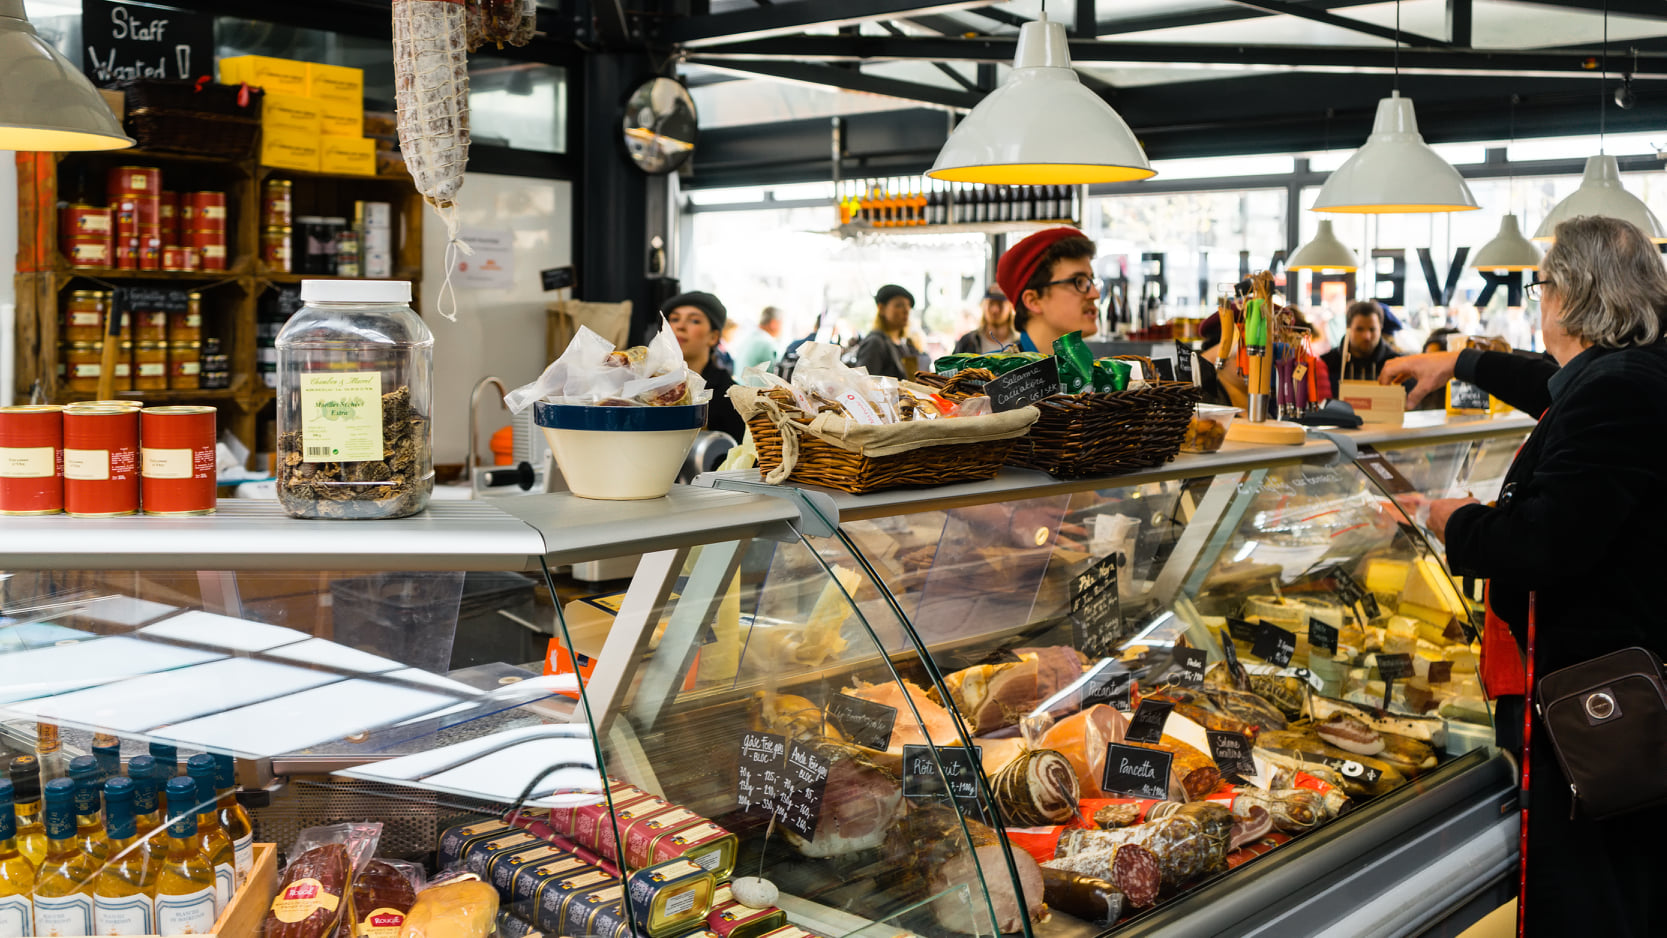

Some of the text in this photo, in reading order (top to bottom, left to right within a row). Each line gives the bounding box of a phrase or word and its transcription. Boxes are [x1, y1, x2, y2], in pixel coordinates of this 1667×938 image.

[111, 6, 169, 42] Staff
[88, 45, 166, 81] Wanted
[1088, 681, 1119, 697] Piccante
[943, 760, 961, 777] uit
[1119, 757, 1155, 779] Pancetta
